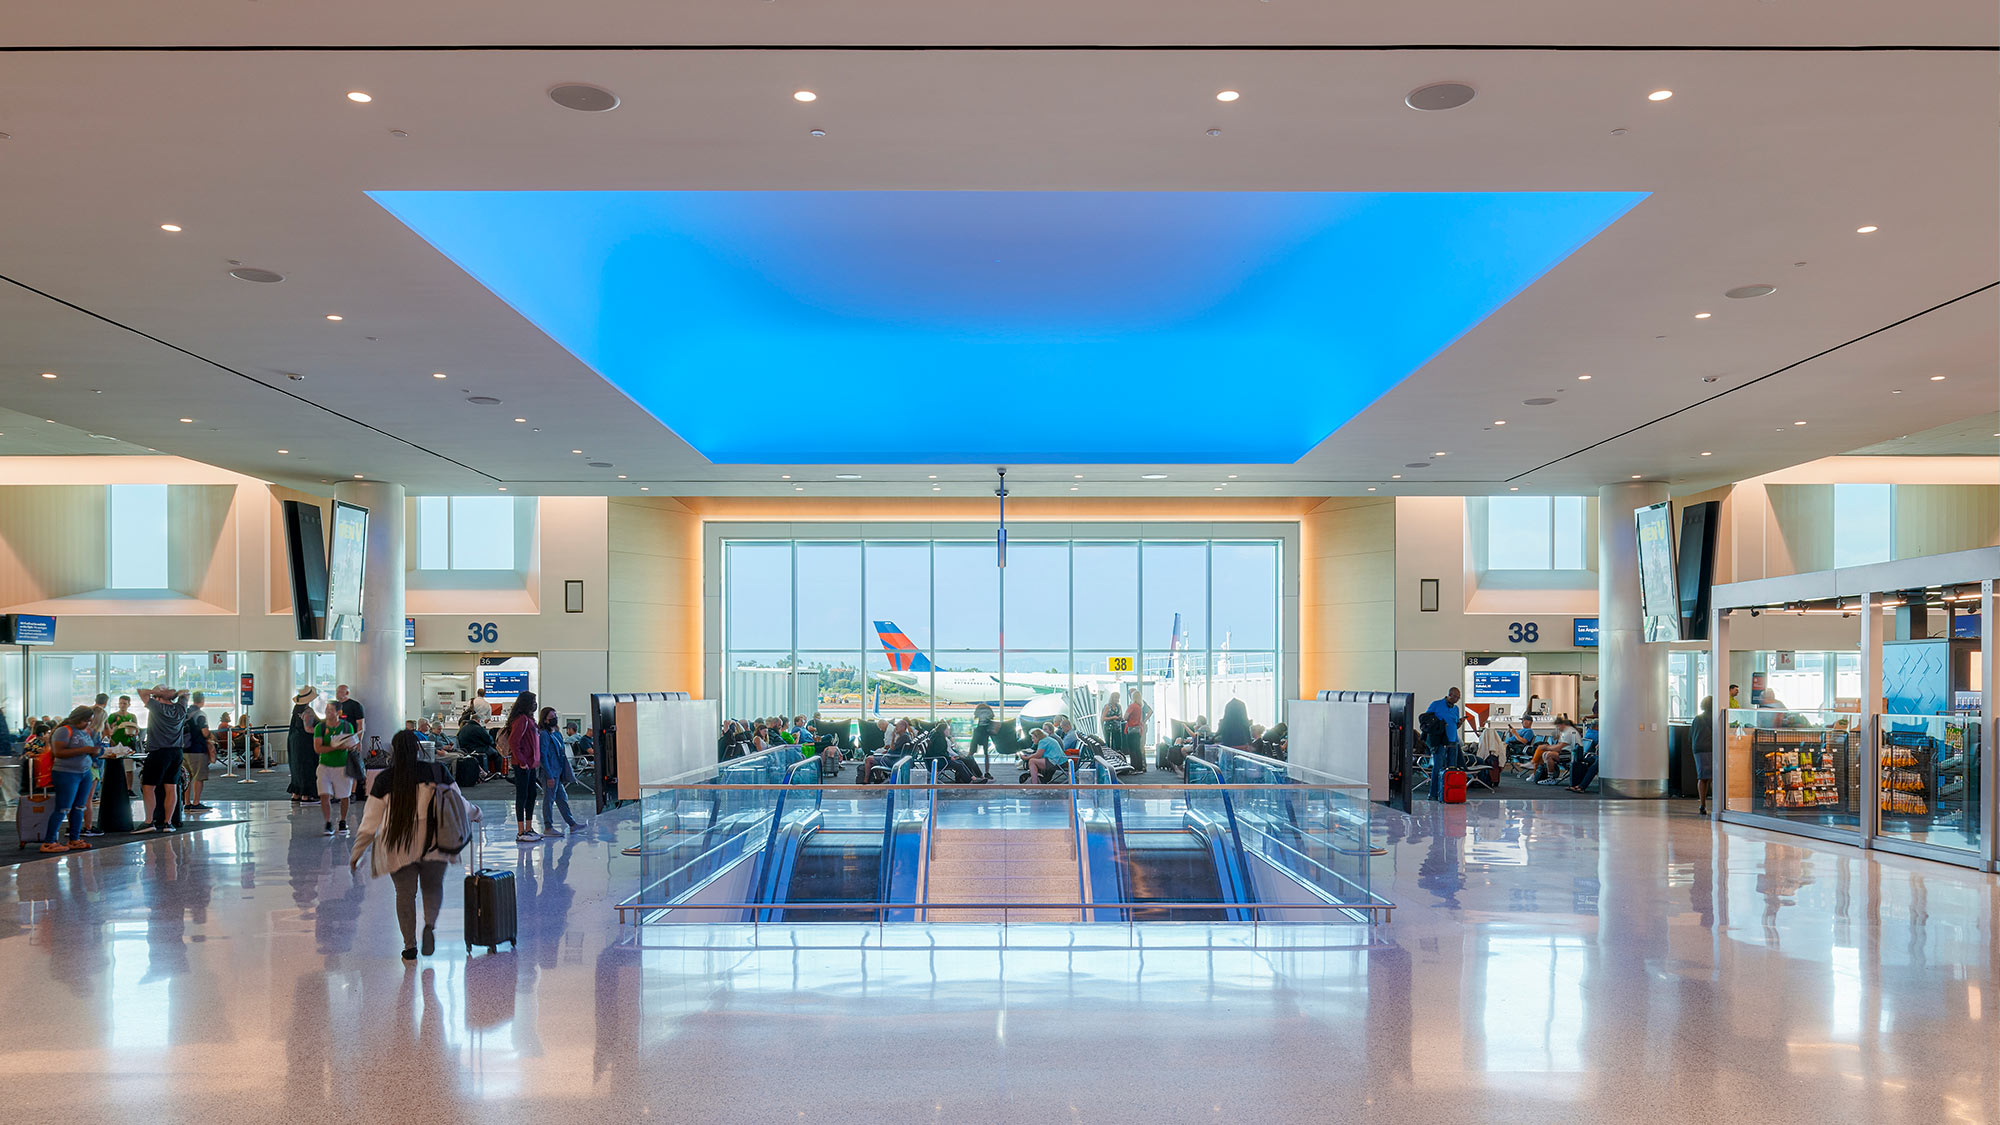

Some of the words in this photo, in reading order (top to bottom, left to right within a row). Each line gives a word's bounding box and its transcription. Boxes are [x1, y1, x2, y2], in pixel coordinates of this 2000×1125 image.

[468, 622, 498, 643] 36
[1508, 622, 1539, 643] 38
[1114, 658, 1127, 671] 38
